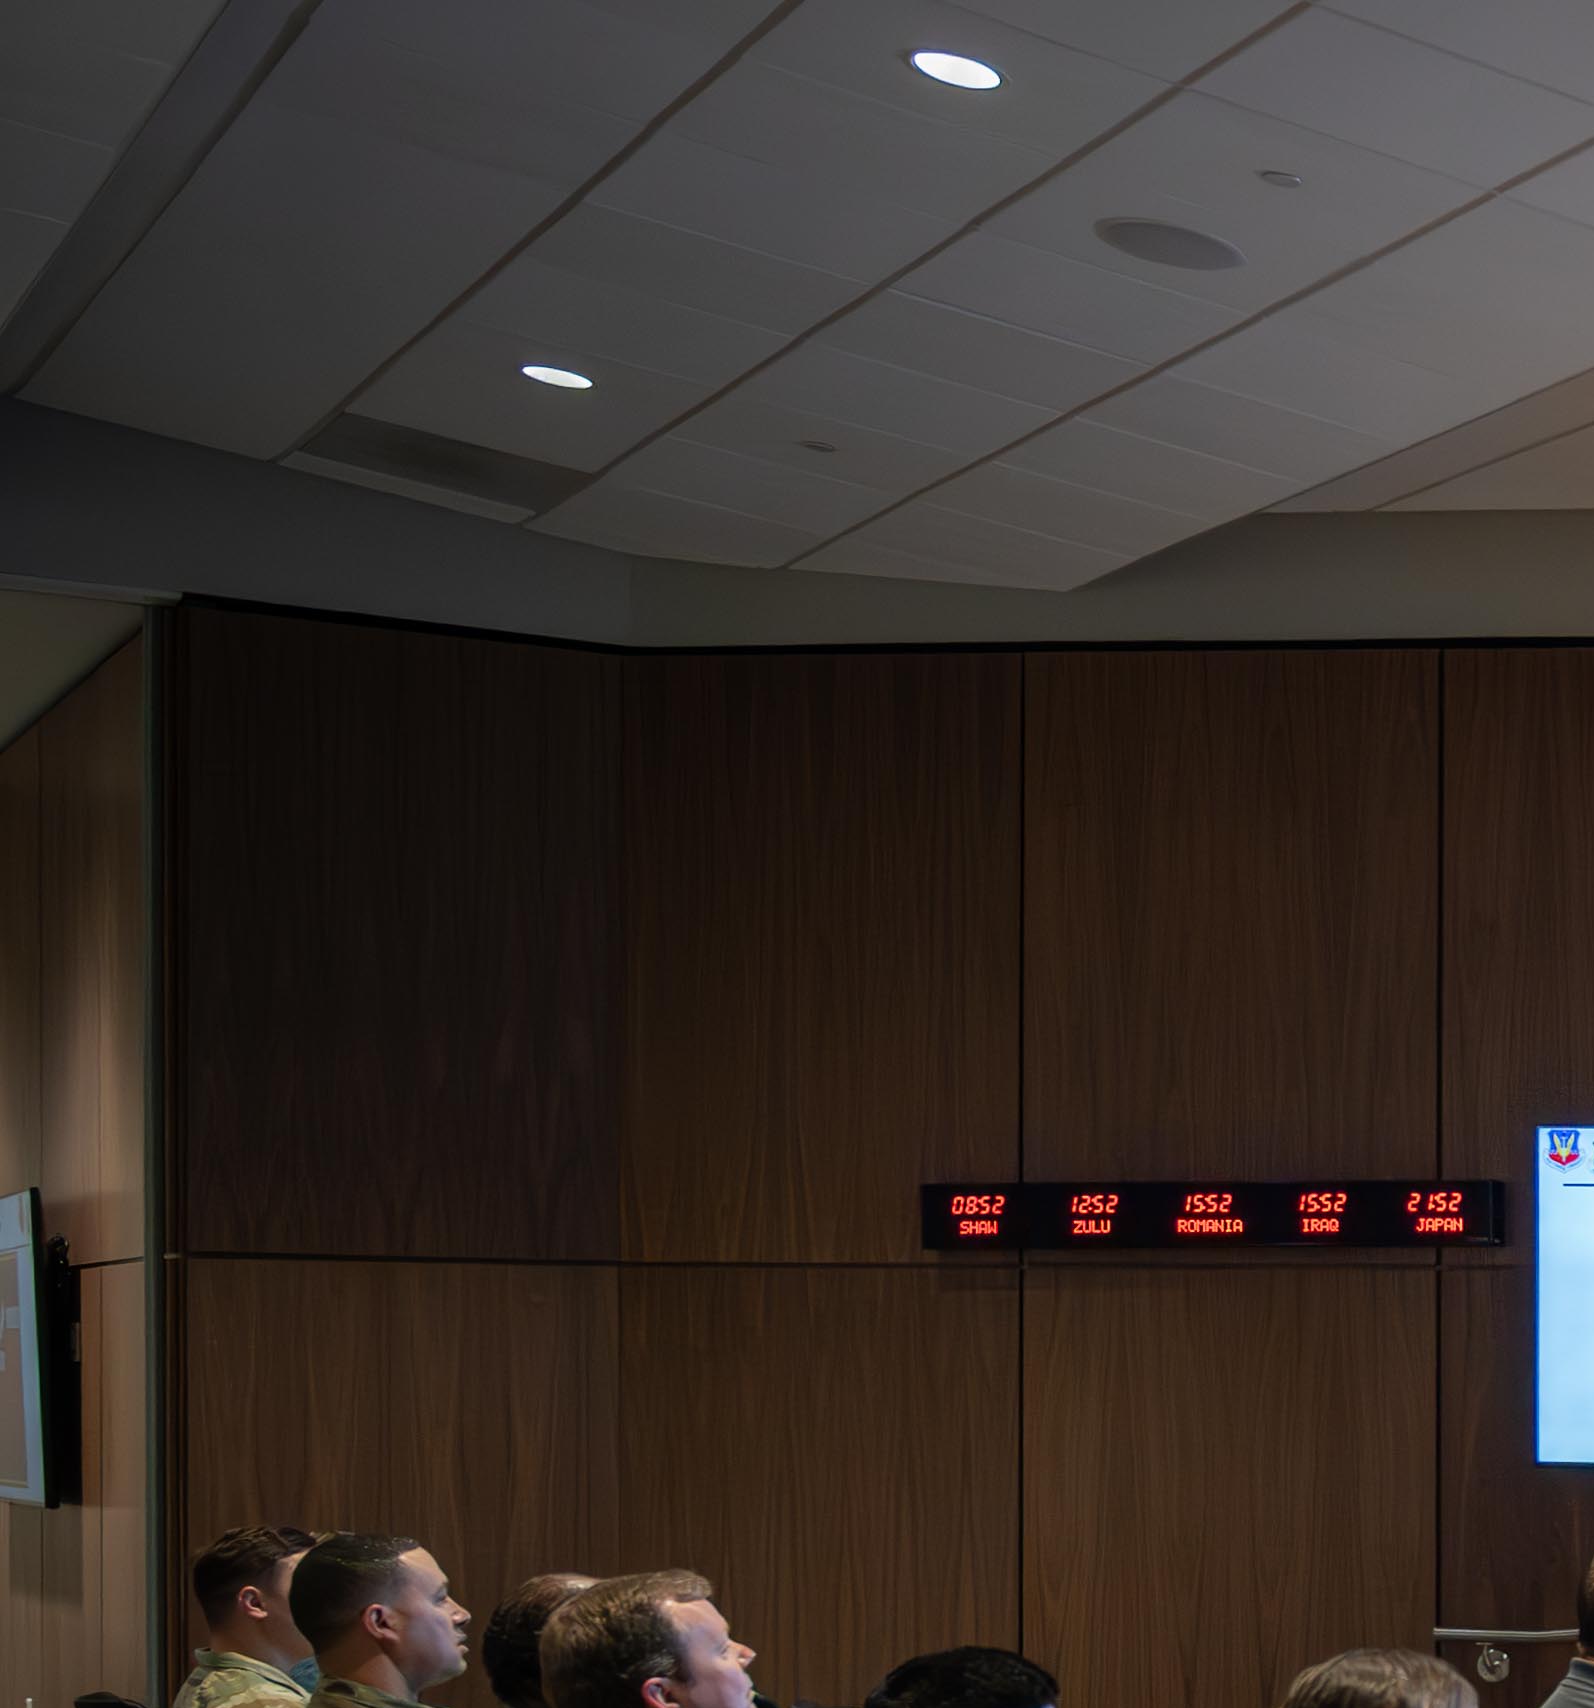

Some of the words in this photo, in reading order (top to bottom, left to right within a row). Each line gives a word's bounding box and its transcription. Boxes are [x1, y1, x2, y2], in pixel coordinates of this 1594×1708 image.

[959, 1220, 998, 1235] SHAW
[1073, 1219, 1111, 1234] ZULU
[1177, 1218, 1243, 1233] ROMANIA
[1302, 1218, 1340, 1232] IRAQ
[1415, 1217, 1463, 1232] JAPAN
